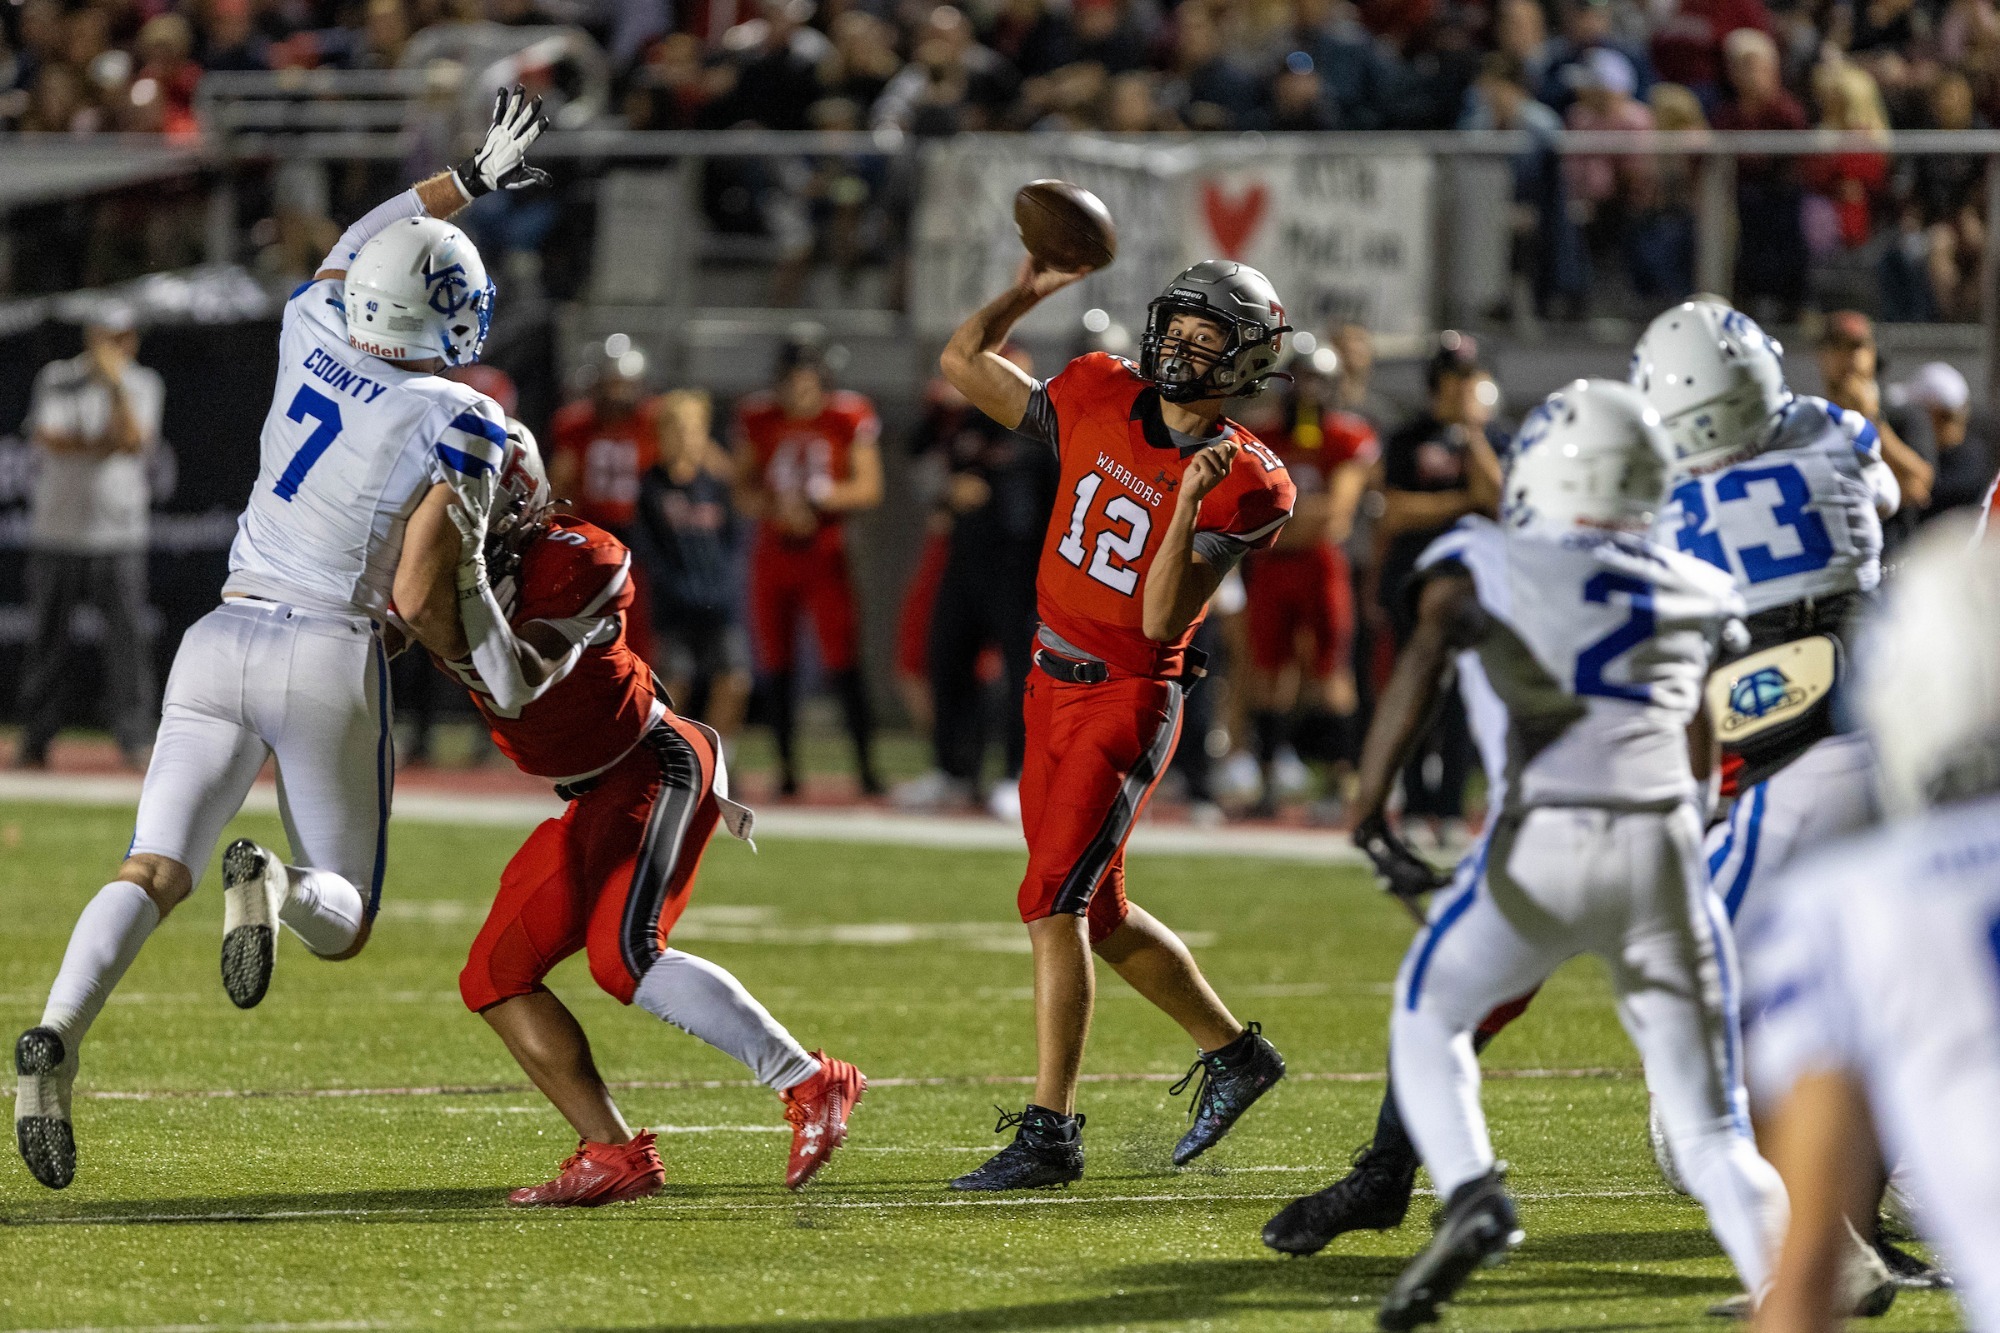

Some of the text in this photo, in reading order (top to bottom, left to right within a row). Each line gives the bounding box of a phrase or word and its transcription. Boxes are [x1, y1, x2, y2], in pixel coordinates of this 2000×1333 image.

[366, 300, 379, 313] 40
[303, 347, 388, 404] COUNTY
[350, 335, 406, 359] Riddell
[272, 382, 344, 503] 7
[1096, 451, 1163, 508] WARRIORS
[1057, 470, 1153, 598] 12
[1574, 570, 1657, 703] 2
